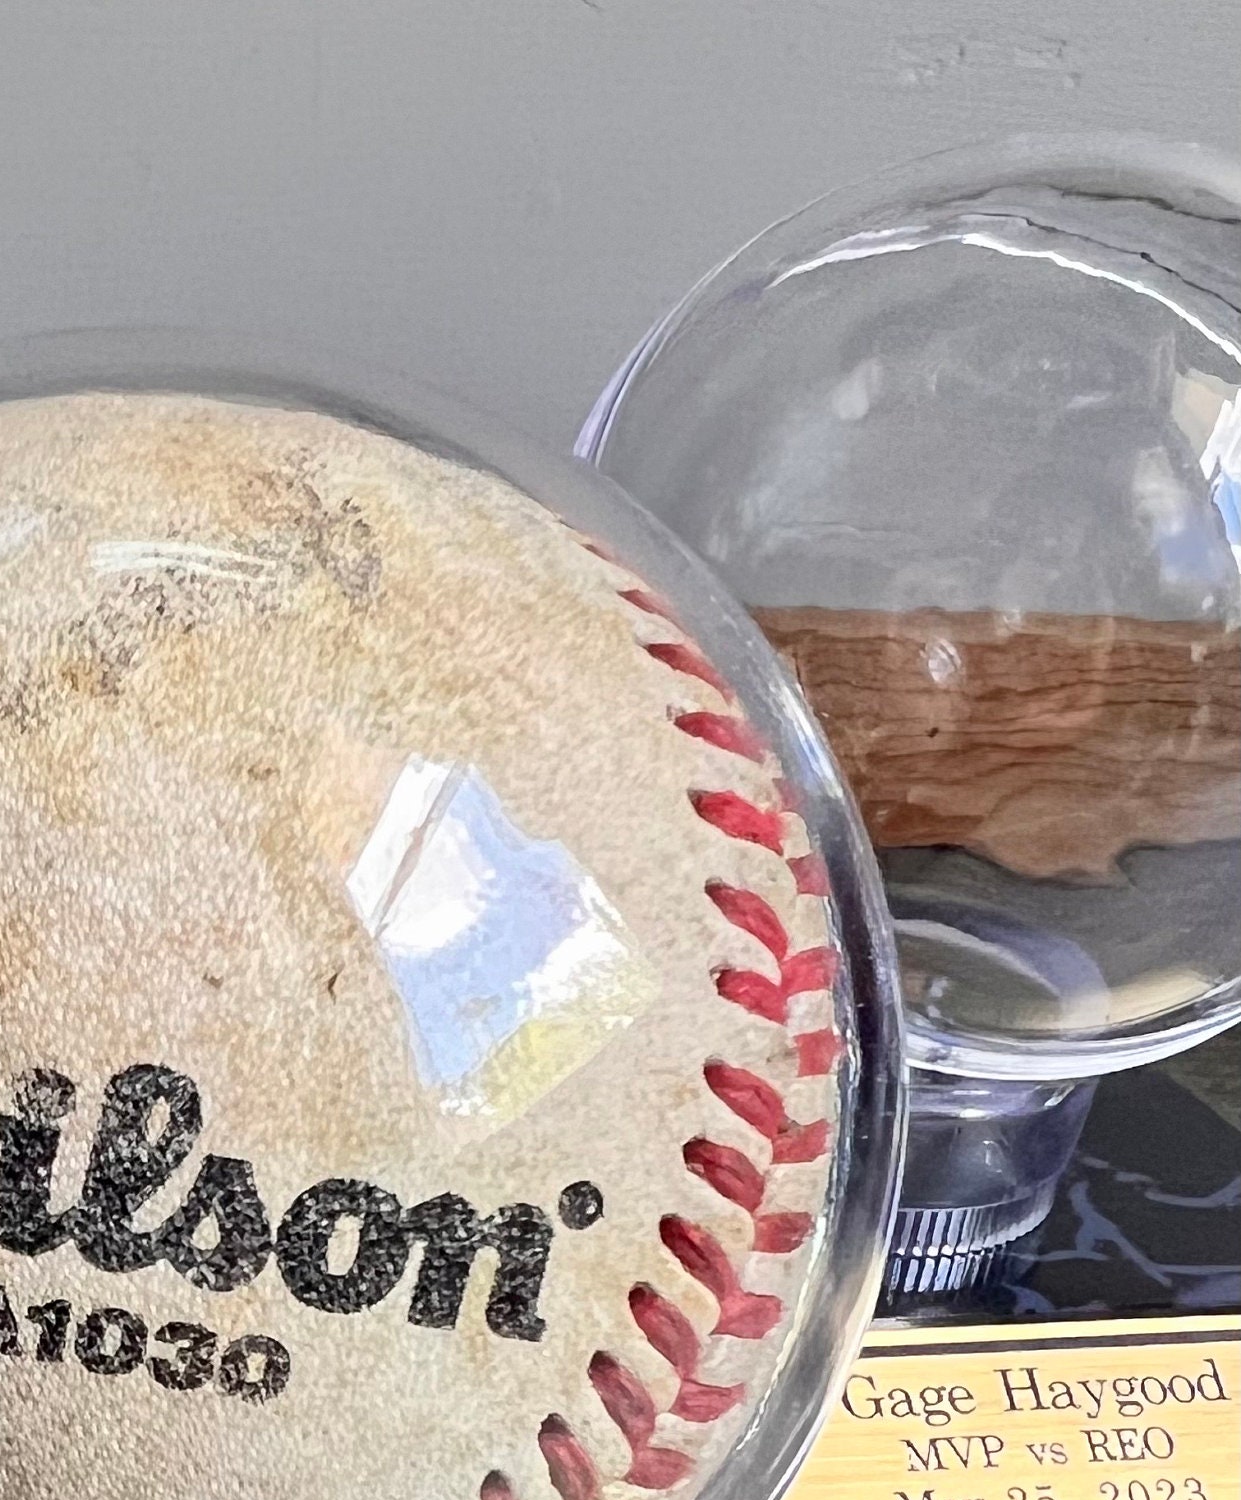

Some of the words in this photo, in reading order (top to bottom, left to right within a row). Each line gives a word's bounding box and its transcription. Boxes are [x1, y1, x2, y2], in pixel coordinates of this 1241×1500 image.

[842, 1375, 977, 1425] Gage
[994, 1359, 1231, 1418] Haygood
[900, 1435, 1003, 1471] MVP
[1027, 1443, 1068, 1465] vs
[1081, 1427, 1174, 1462] REO
